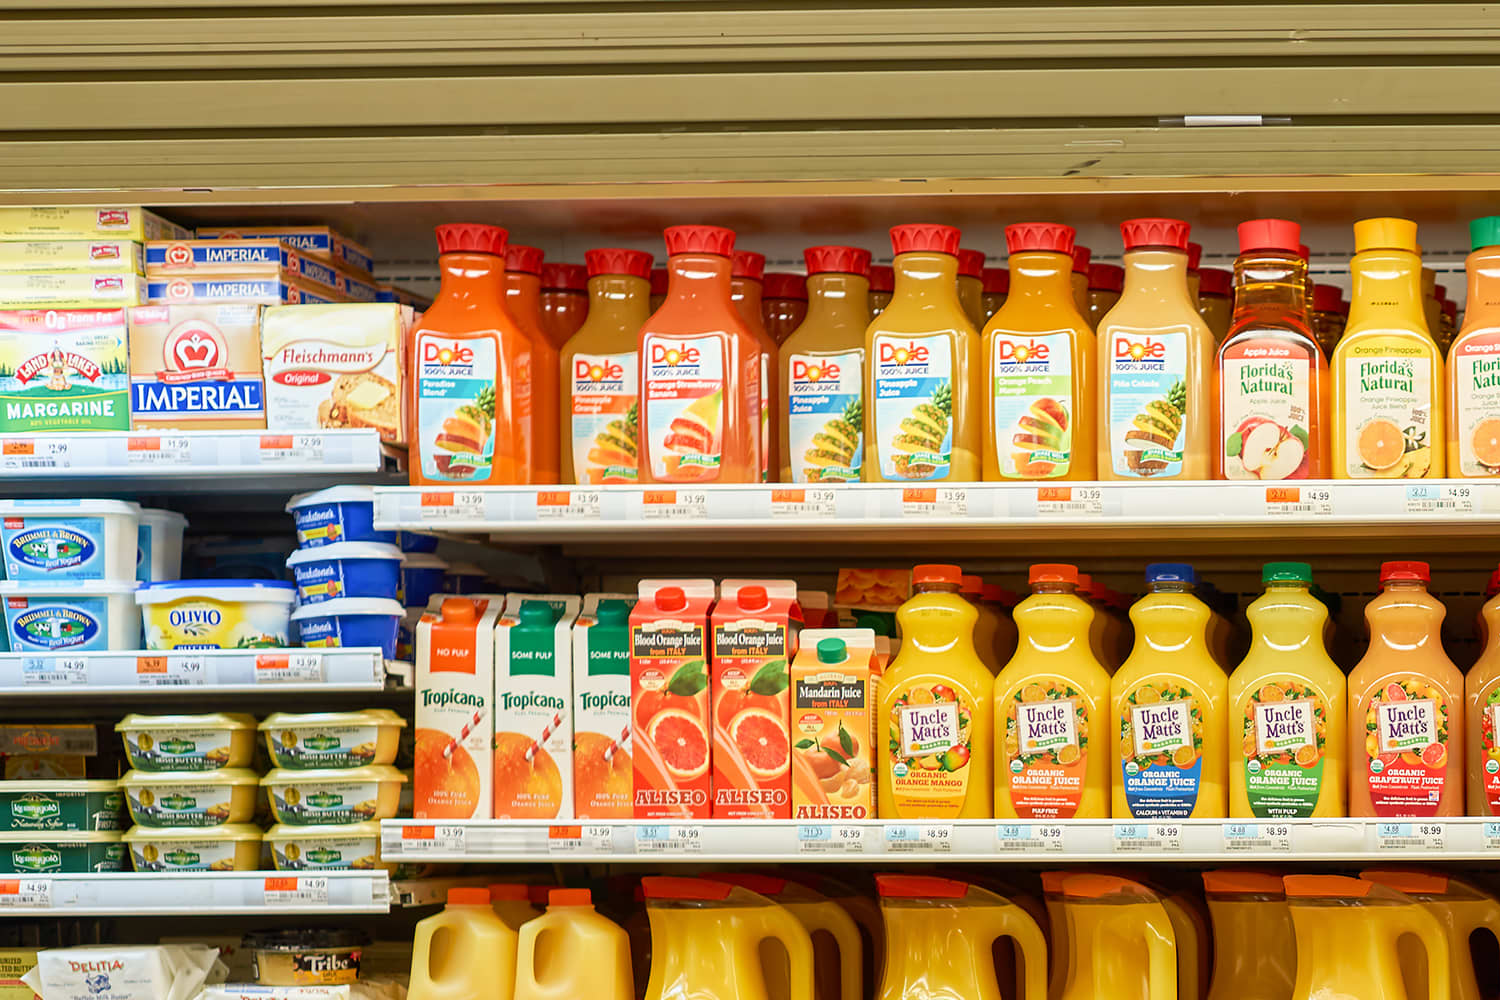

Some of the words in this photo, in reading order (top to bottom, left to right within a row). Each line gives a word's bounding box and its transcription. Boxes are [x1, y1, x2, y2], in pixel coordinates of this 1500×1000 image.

[206, 247, 270, 263] IMPERIAL
[424, 342, 474, 364] Dole
[879, 341, 929, 363] Dole
[1115, 337, 1165, 359] Dole
[1243, 346, 1264, 358] Apple
[1266, 346, 1289, 356] Juice
[282, 348, 374, 364] Fleischmann's
[880, 366, 902, 375] 100%
[904, 365, 929, 374] JUICE
[1240, 362, 1293, 380] Florida's
[284, 372, 320, 385] Original
[1240, 378, 1294, 396] Natural
[136, 383, 260, 412] IMPERIAL
[7, 400, 115, 419] MARGARINE
[1308, 490, 1329, 501] $4.99
[169, 609, 221, 626] OLIVIO
[634, 634, 655, 646] Blood
[656, 634, 681, 648] Orange
[682, 634, 701, 646] Juice
[436, 648, 449, 657] NO
[451, 649, 470, 658] PULP
[649, 648, 664, 656] from
[666, 647, 686, 656] ITALY
[422, 688, 485, 709] Tropicana
[799, 687, 839, 699] Mandarin
[841, 687, 861, 699] Juice
[1026, 706, 1065, 723] Uncle
[1028, 721, 1067, 738] Matt's
[1027, 769, 1065, 777] ORGANIC
[1369, 776, 1419, 784] GRAPEFRUIT
[1421, 776, 1444, 785] JUICE
[1012, 776, 1048, 786] ORANGE
[1050, 777, 1080, 786] JUICE
[636, 791, 706, 806] ALISEO
[678, 829, 699, 839] $8.99
[1040, 827, 1060, 838] $8.99
[305, 954, 348, 972] Tribe
